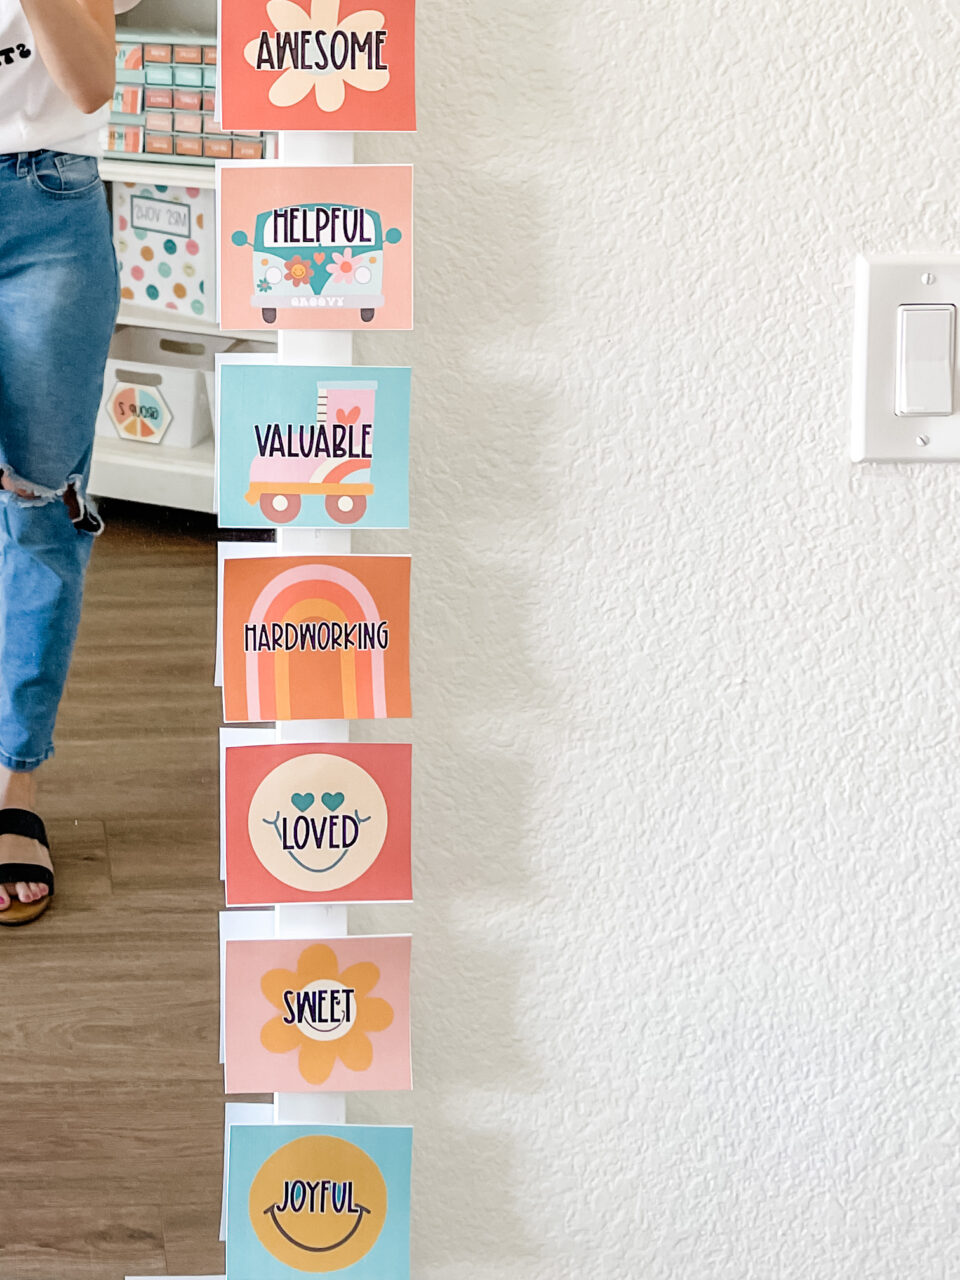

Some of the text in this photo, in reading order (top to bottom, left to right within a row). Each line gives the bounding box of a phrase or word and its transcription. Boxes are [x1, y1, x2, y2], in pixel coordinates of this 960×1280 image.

[257, 30, 387, 70] AWESOME
[273, 207, 372, 243] HELPFUL
[254, 424, 372, 458] VALUABLE
[245, 621, 389, 652] HARDWORKING
[281, 815, 359, 850] LOVED
[283, 989, 355, 1024] SWEET
[276, 1180, 359, 1213] JOYFUL
